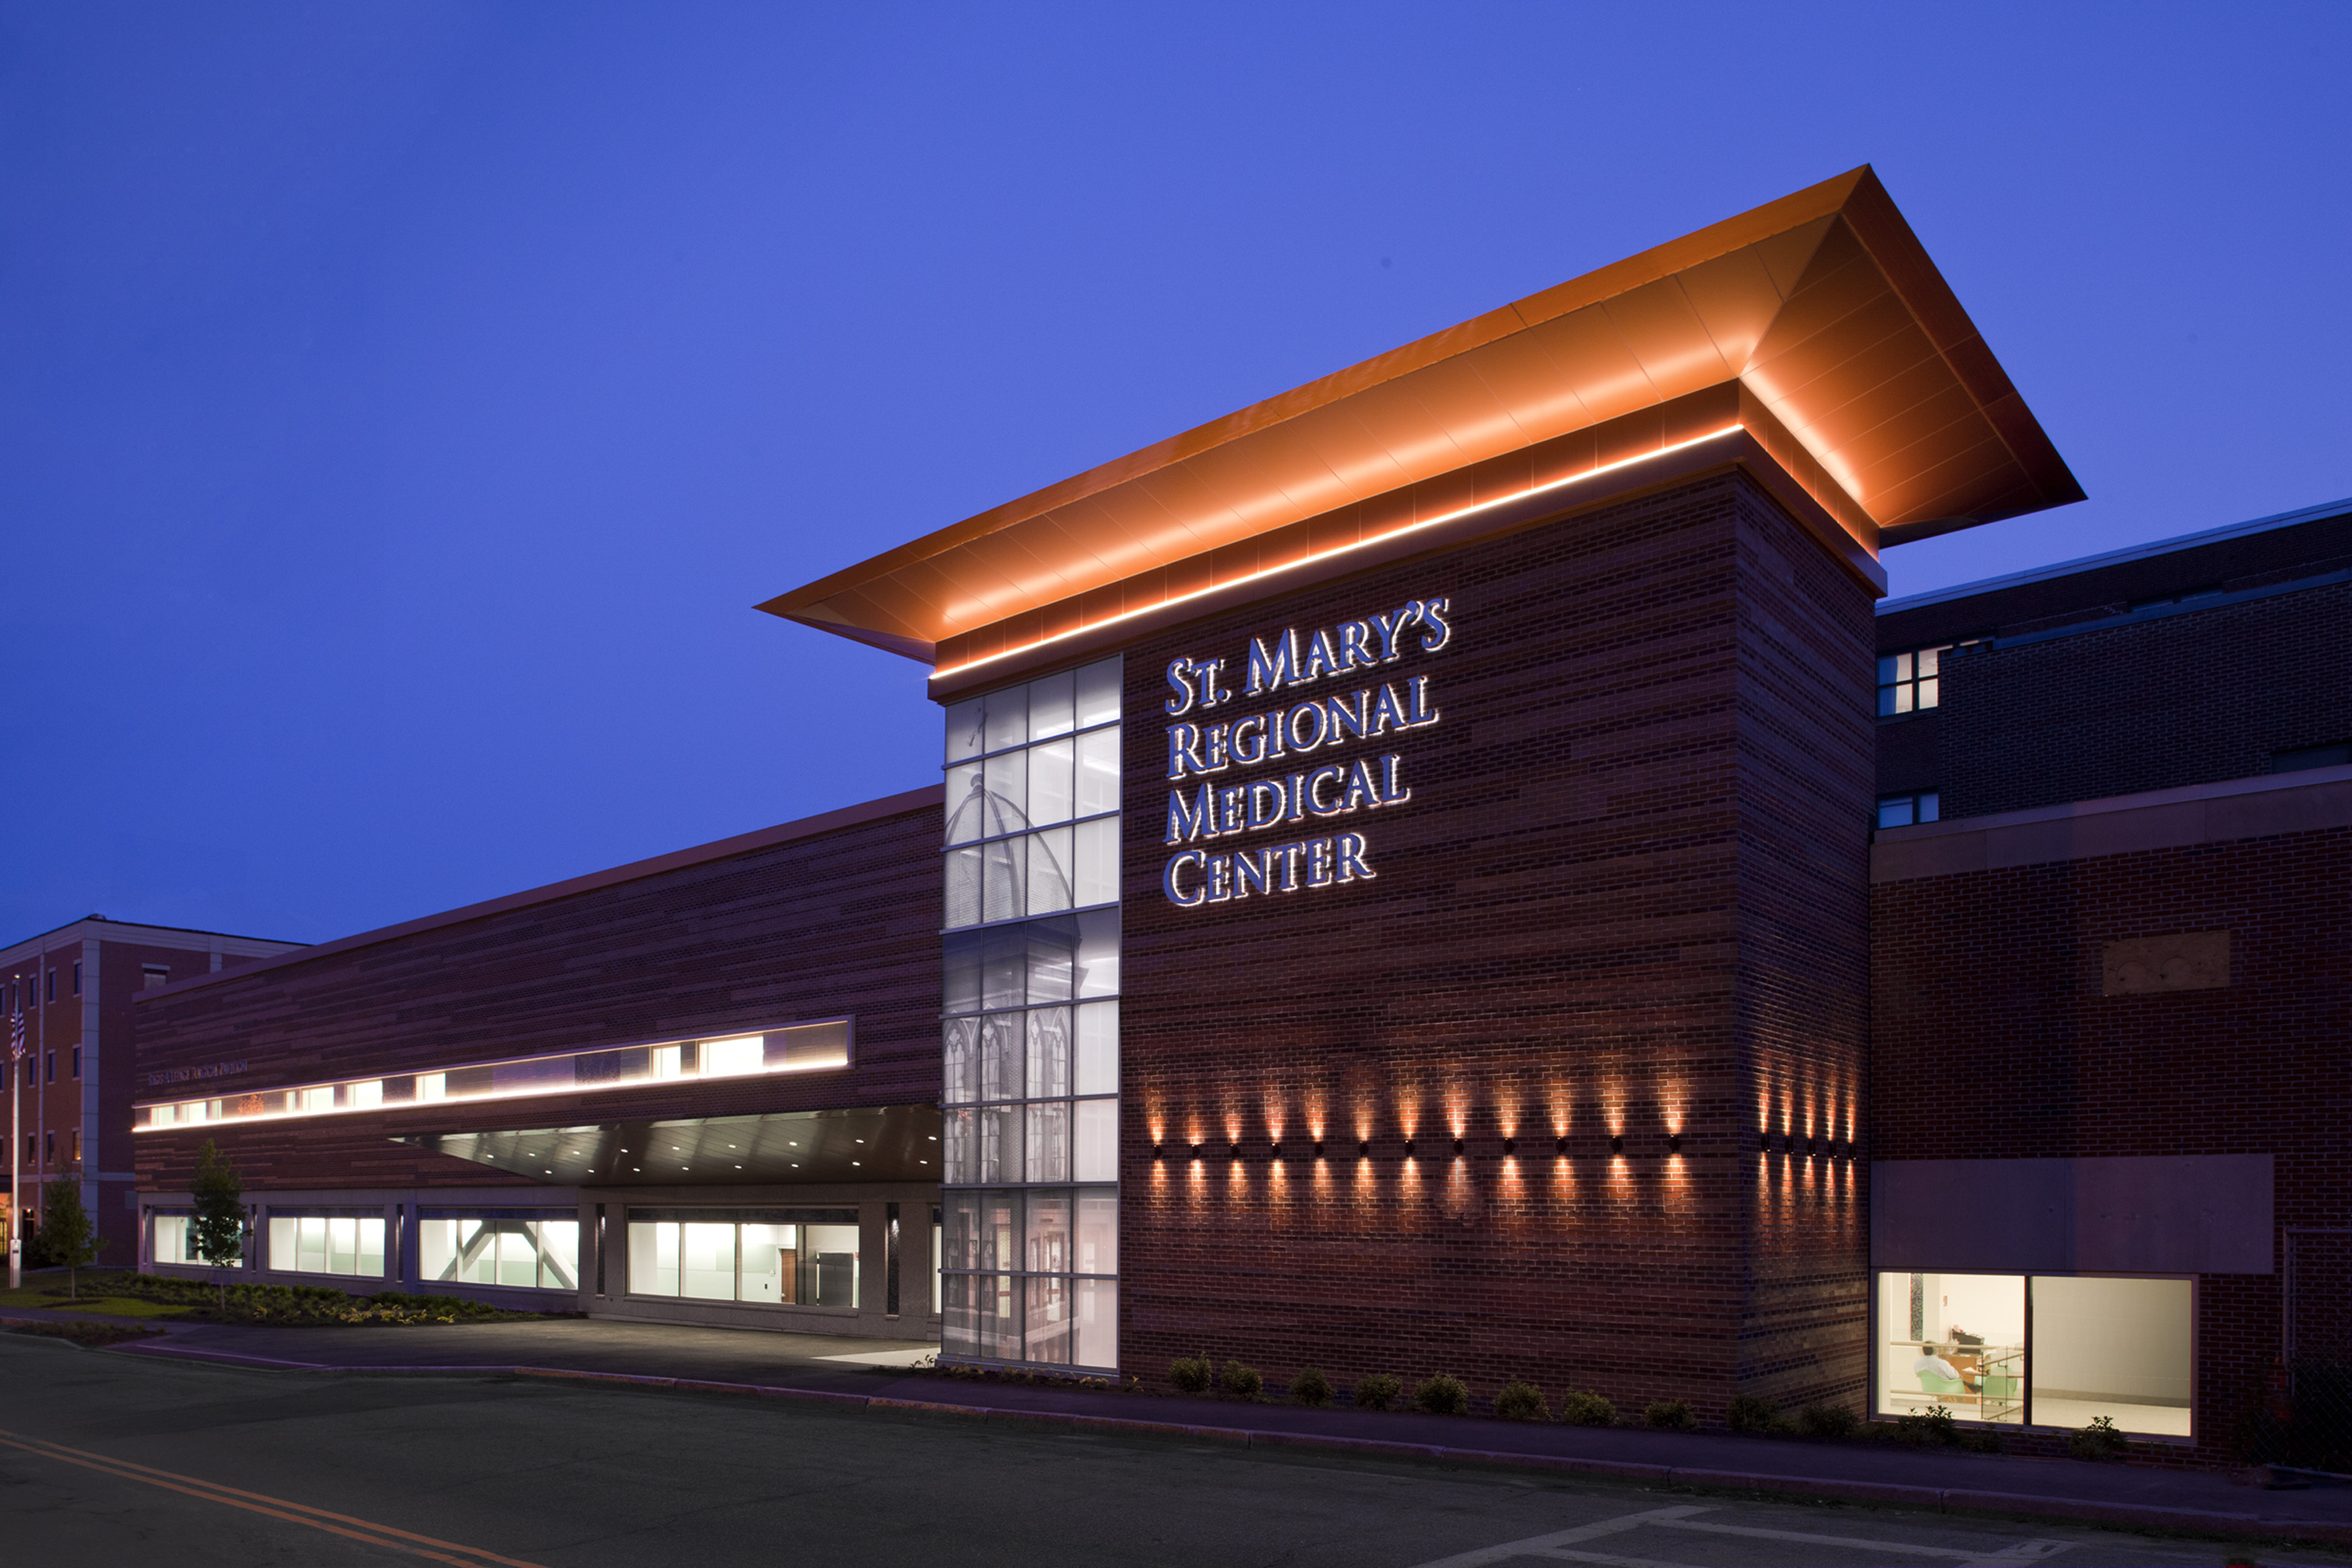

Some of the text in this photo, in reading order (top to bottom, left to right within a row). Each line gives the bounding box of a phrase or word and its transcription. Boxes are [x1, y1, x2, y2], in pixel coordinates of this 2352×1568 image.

[1166, 598, 1449, 715] ST. MARY'S
[1166, 676, 1438, 779] REGIONAL
[1163, 754, 1411, 844] MEDICAL
[1163, 832, 1376, 906] CENTER
